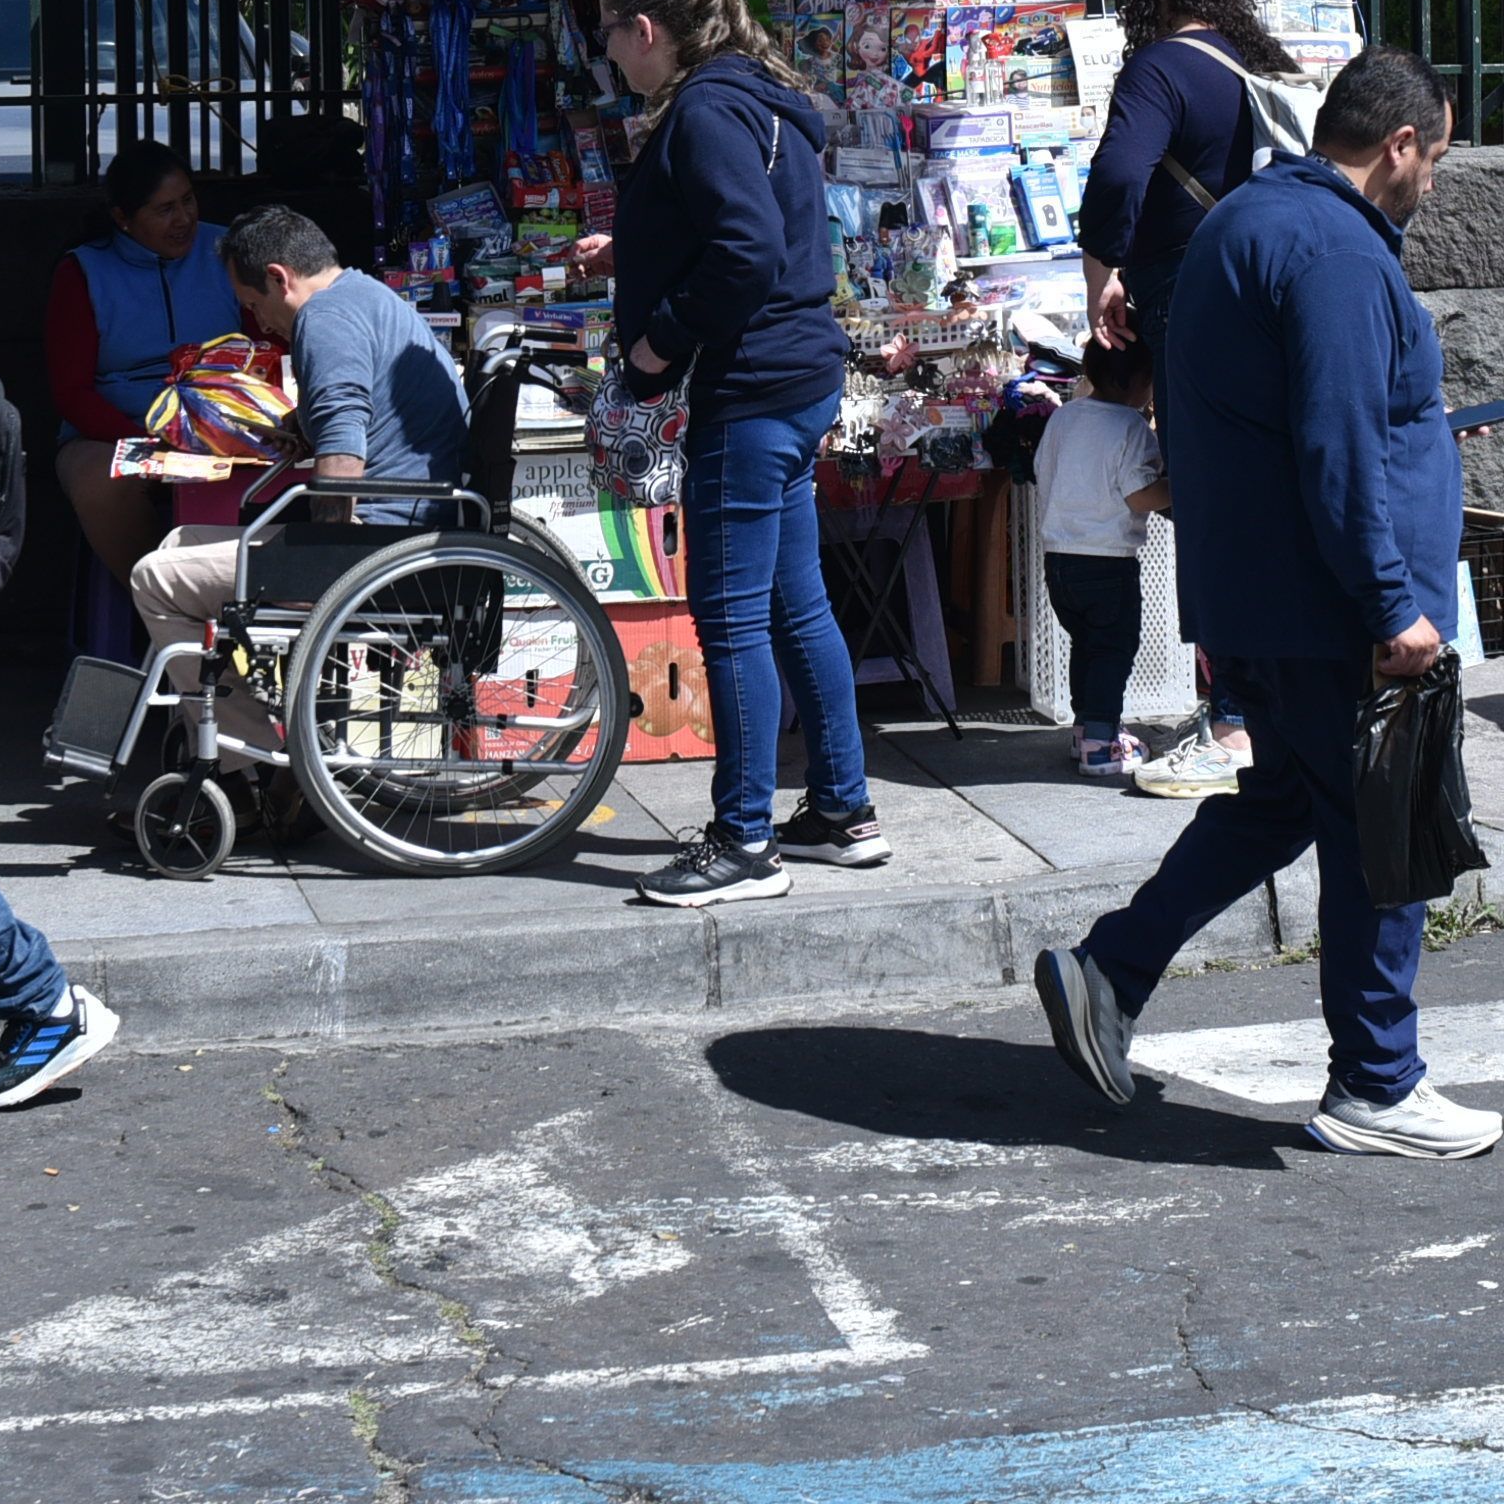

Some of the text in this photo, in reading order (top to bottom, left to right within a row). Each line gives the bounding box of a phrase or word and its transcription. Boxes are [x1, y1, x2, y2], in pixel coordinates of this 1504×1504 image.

[524, 457, 595, 484] apples
[549, 497, 596, 513] premium
[551, 508, 577, 521] fruit
